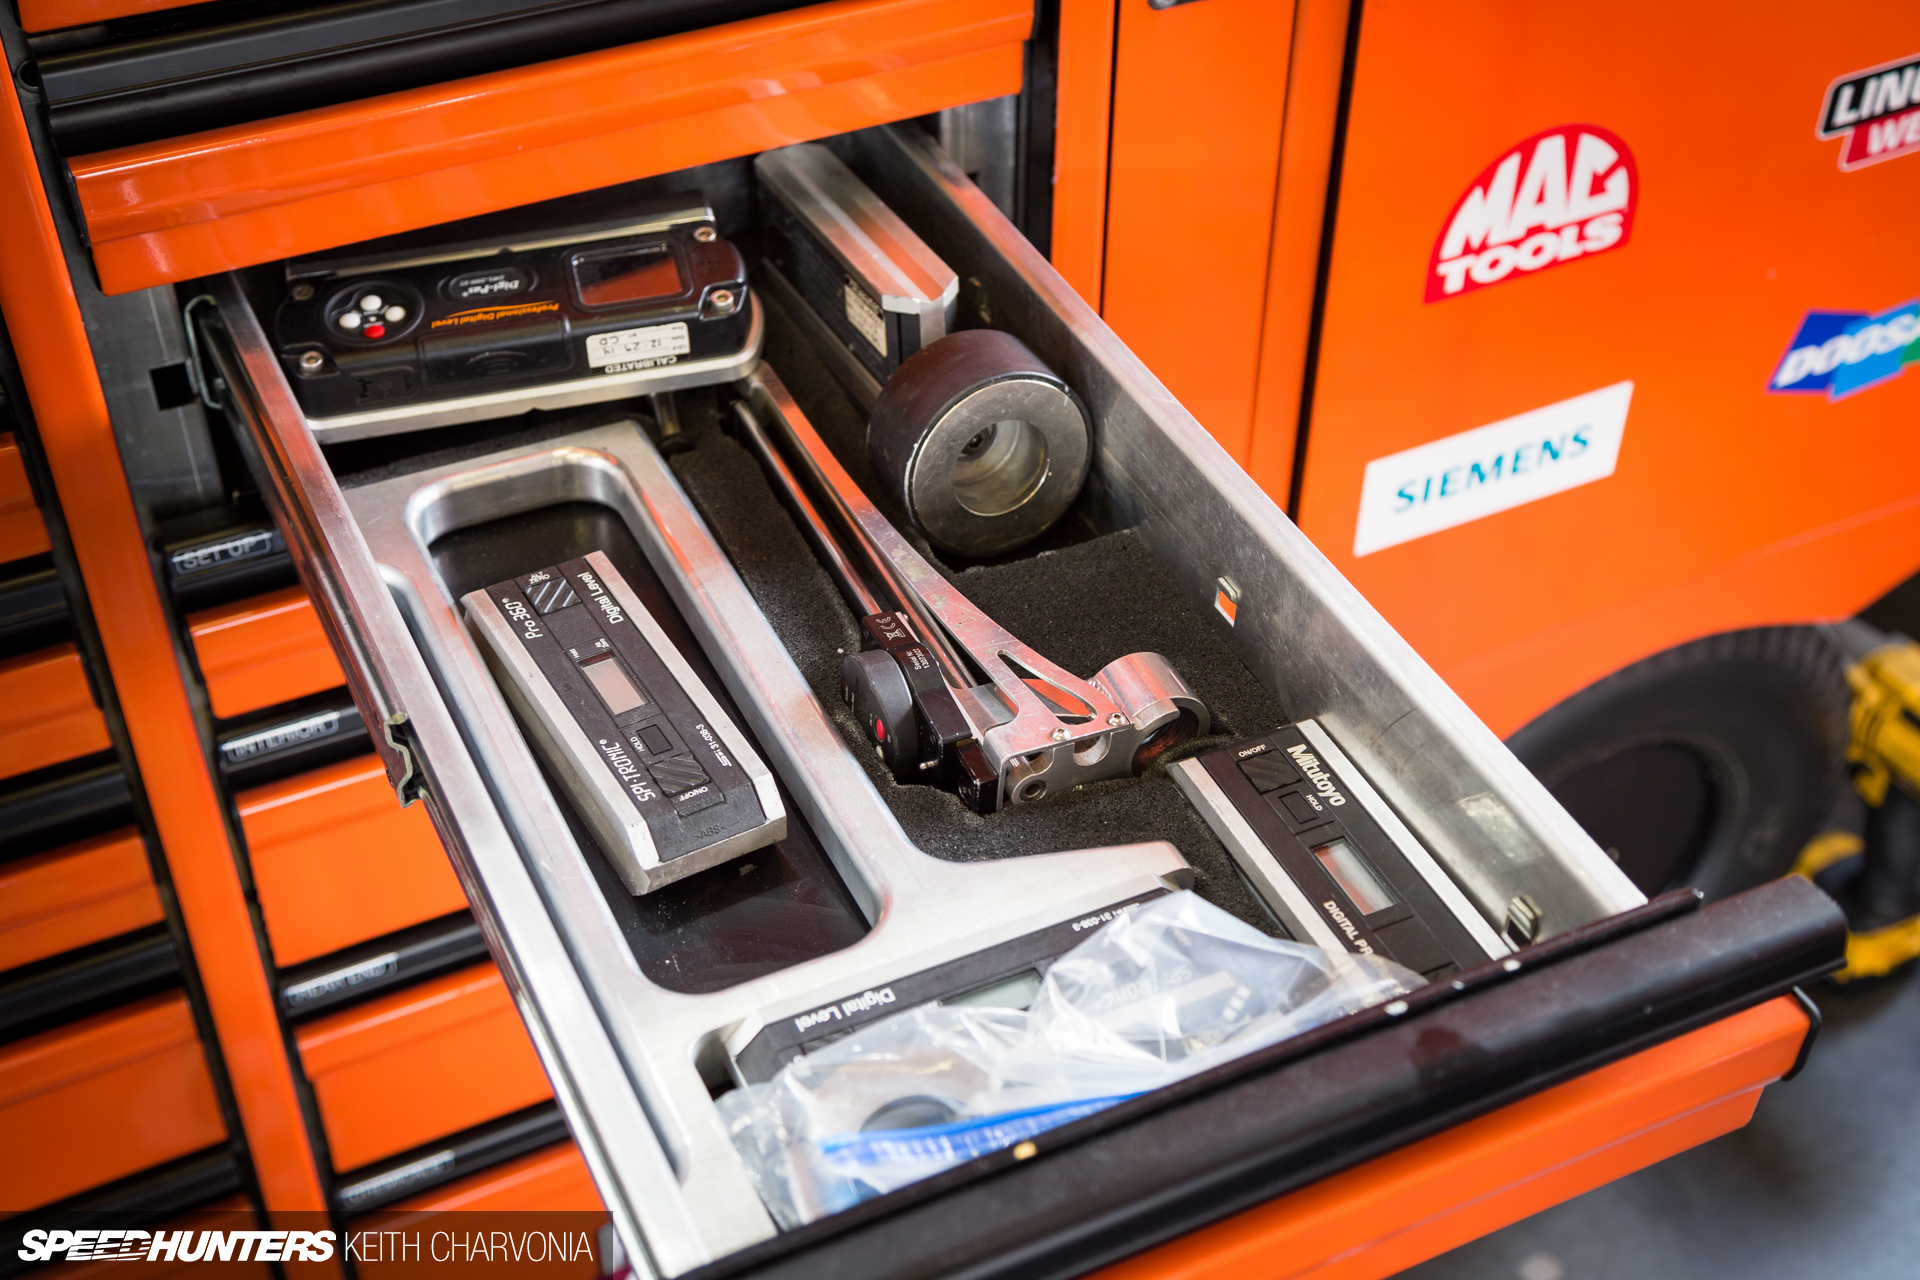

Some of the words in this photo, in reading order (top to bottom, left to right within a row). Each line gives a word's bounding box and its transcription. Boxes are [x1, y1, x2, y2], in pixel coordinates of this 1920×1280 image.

[1439, 132, 1630, 262] MAC
[1436, 211, 1624, 296] TOOLS
[459, 312, 496, 326] Digital
[495, 302, 560, 320] Professional
[430, 317, 460, 330] Level
[604, 354, 678, 375] CALIBRATED
[1392, 423, 1594, 516] SIEMENS
[576, 571, 605, 597] Level
[503, 600, 532, 622] 360
[593, 594, 625, 625] Digital
[523, 620, 544, 640] Pro
[629, 735, 646, 753] HOLD
[695, 722, 721, 750] 31-038-3
[1237, 743, 1267, 758] ON/OFF
[1286, 743, 1346, 807] Mitutoyo
[678, 785, 709, 802] ON/OFF
[1305, 793, 1324, 812] HOLD
[1322, 899, 1356, 941] DIGITAL
[840, 986, 897, 1018] Digital
[794, 1004, 843, 1033] Level
